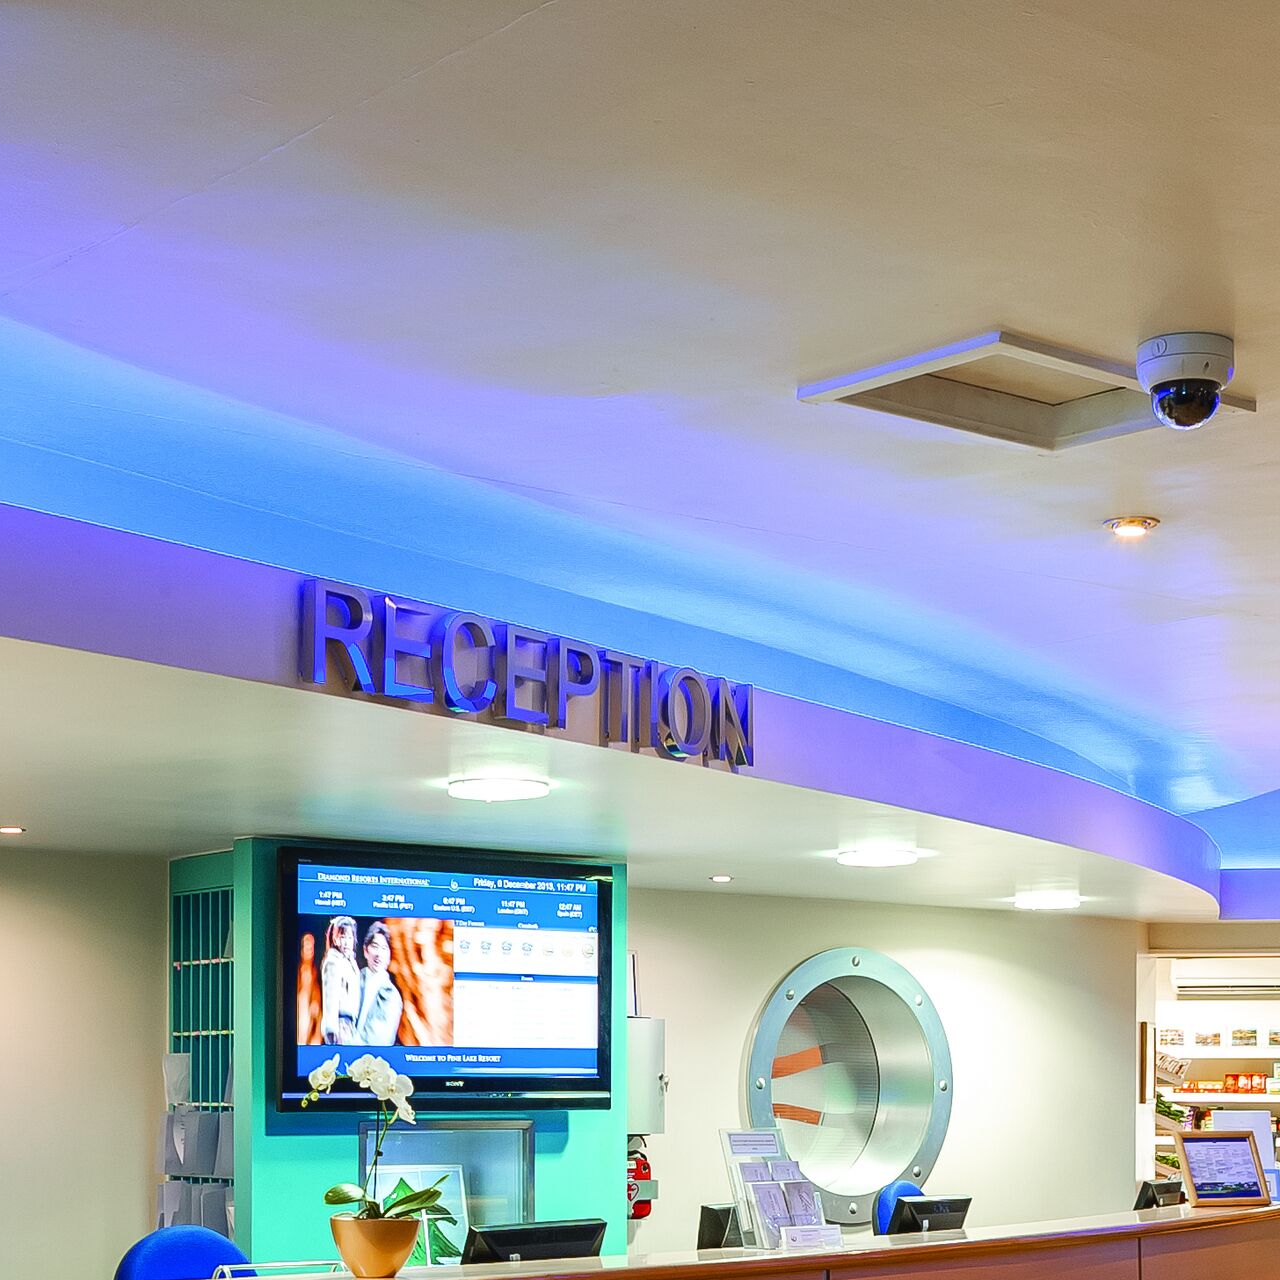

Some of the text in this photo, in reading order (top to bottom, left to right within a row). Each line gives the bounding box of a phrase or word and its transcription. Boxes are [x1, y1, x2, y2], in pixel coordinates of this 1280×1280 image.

[303, 577, 754, 768] RECEPTION
[473, 877, 497, 889] Friday,
[503, 880, 536, 890] December
[556, 882, 574, 892] 11:47
[575, 884, 586, 893] PM
